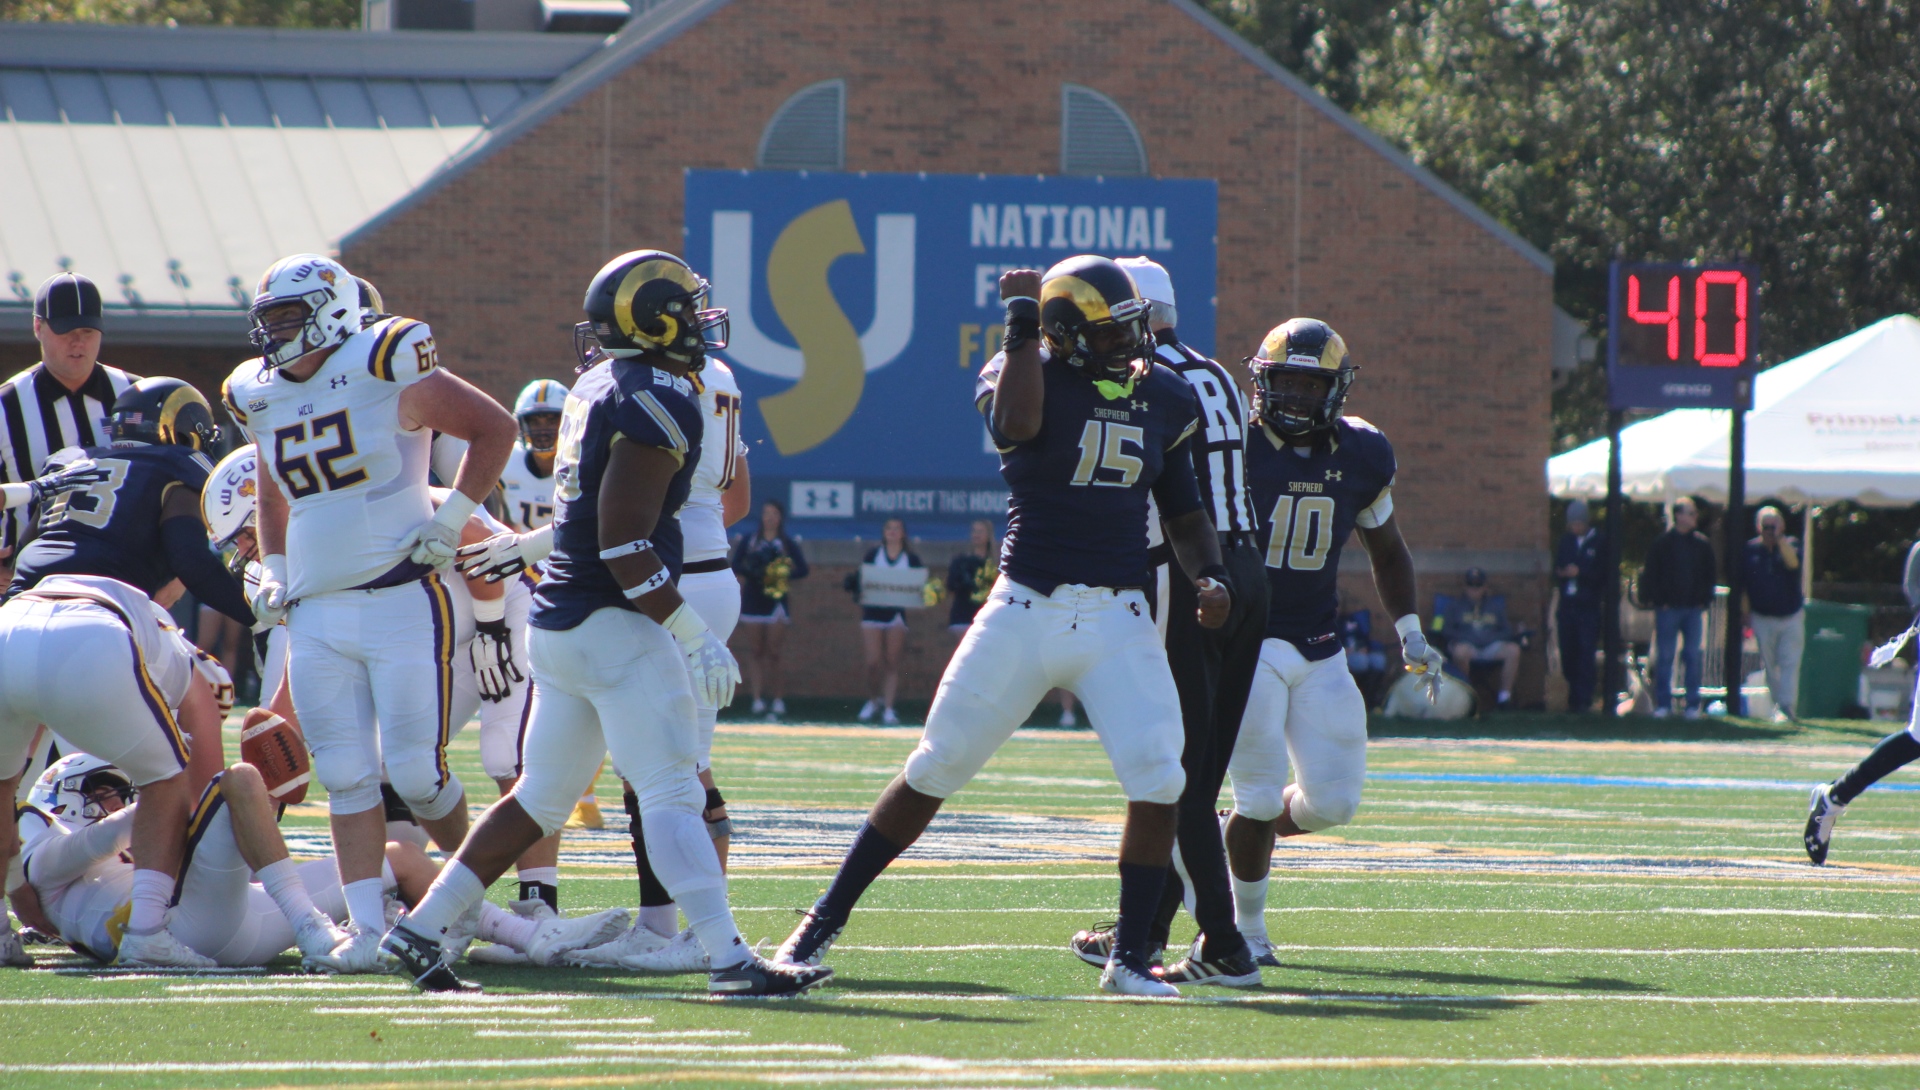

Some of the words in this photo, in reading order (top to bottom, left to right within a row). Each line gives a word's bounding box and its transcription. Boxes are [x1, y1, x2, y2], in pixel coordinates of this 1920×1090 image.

[970, 203, 1173, 250] NATIONAL
[1627, 270, 1747, 367] 40
[297, 403, 314, 417] WCU
[1094, 407, 1130, 421] SHEPHERD
[1182, 368, 1241, 443] R
[274, 407, 370, 499] 62
[1070, 420, 1144, 488] 15
[220, 461, 256, 505] WCU
[862, 490, 934, 511] PROTECT
[938, 490, 968, 512] THIS
[1288, 481, 1323, 493] SHEPHERD
[1265, 495, 1335, 571] 10
